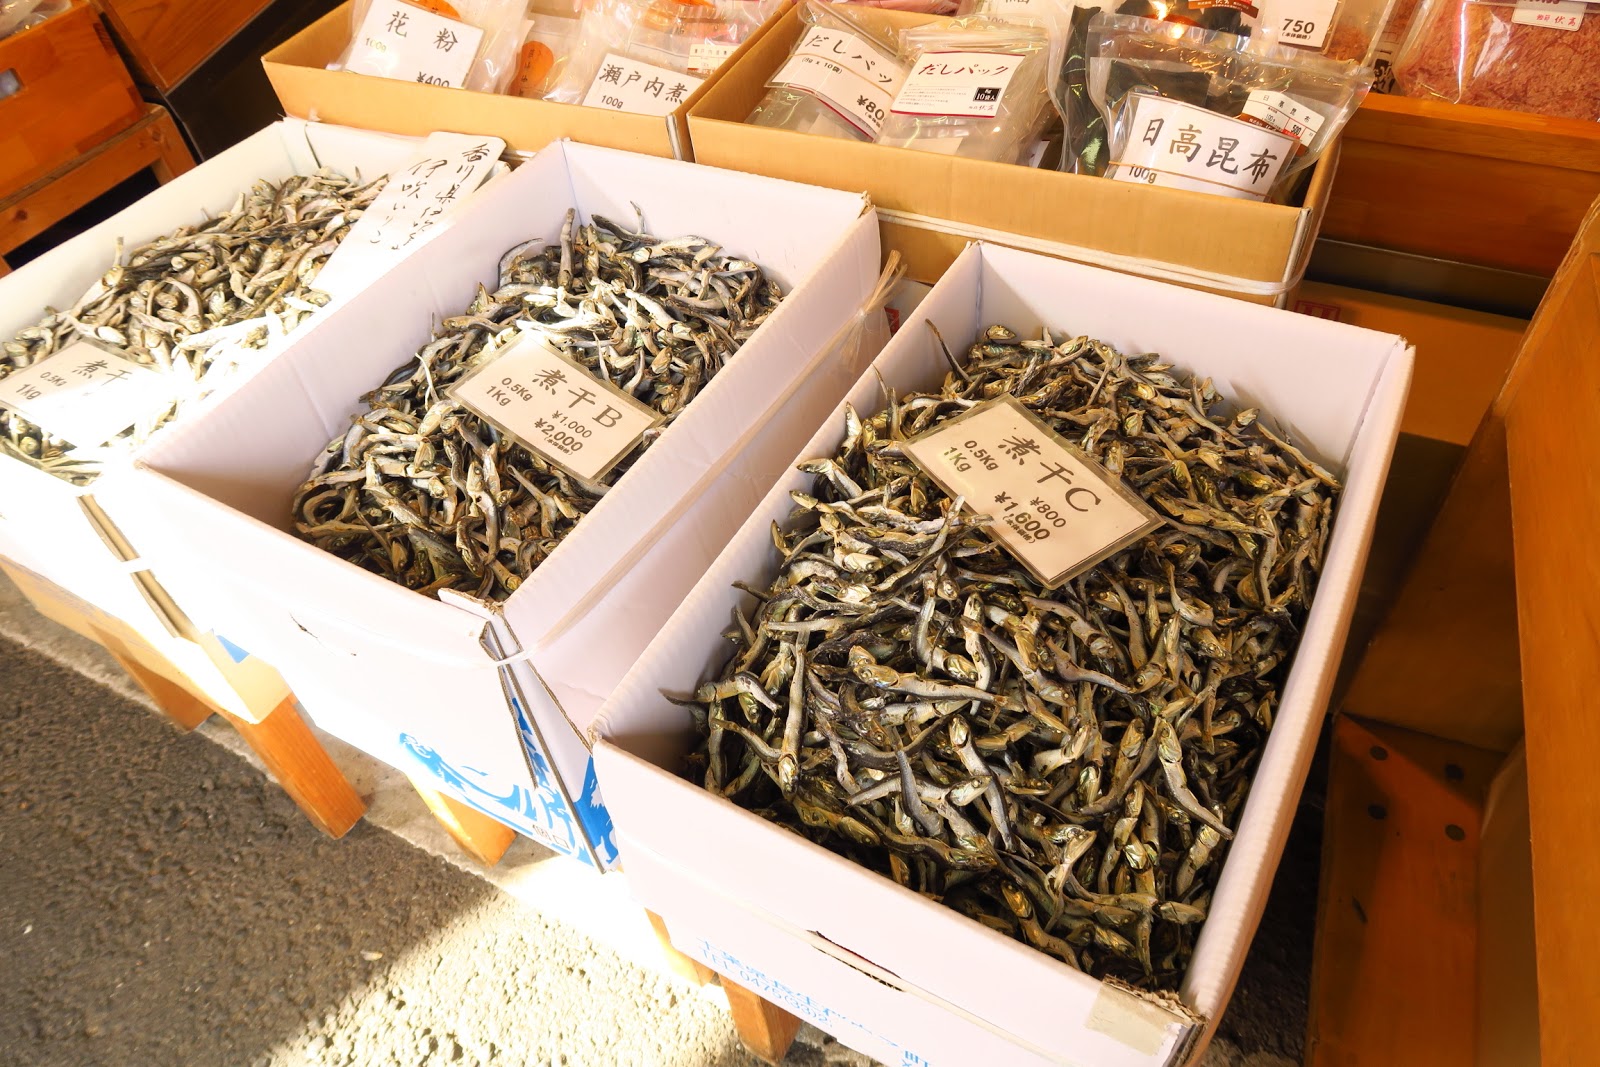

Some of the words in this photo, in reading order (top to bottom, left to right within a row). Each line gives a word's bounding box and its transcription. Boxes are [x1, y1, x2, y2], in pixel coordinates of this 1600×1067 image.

[386, 11, 459, 52] 花粉
[1282, 18, 1315, 34] 750
[365, 37, 387, 53] 100g
[598, 63, 689, 104] 瀬戸内煮
[918, 63, 1009, 76] だしパック
[600, 94, 624, 110] 100g
[857, 95, 886, 122] ¥80
[1142, 117, 1278, 185] 日高昆布
[1128, 164, 1158, 184] 100g
[484, 385, 512, 407] 1Kg
[501, 377, 534, 402] 0.5Kg
[533, 418, 584, 452] ¥2,000
[551, 410, 593, 439] ¥1,000
[943, 446, 972, 473] 1Kg
[963, 440, 999, 471] 0.5Kg
[993, 491, 1051, 541] ¥1,600
[1029, 496, 1067, 528] ¥800
[740, 970, 833, 1029] 0475(33)2
